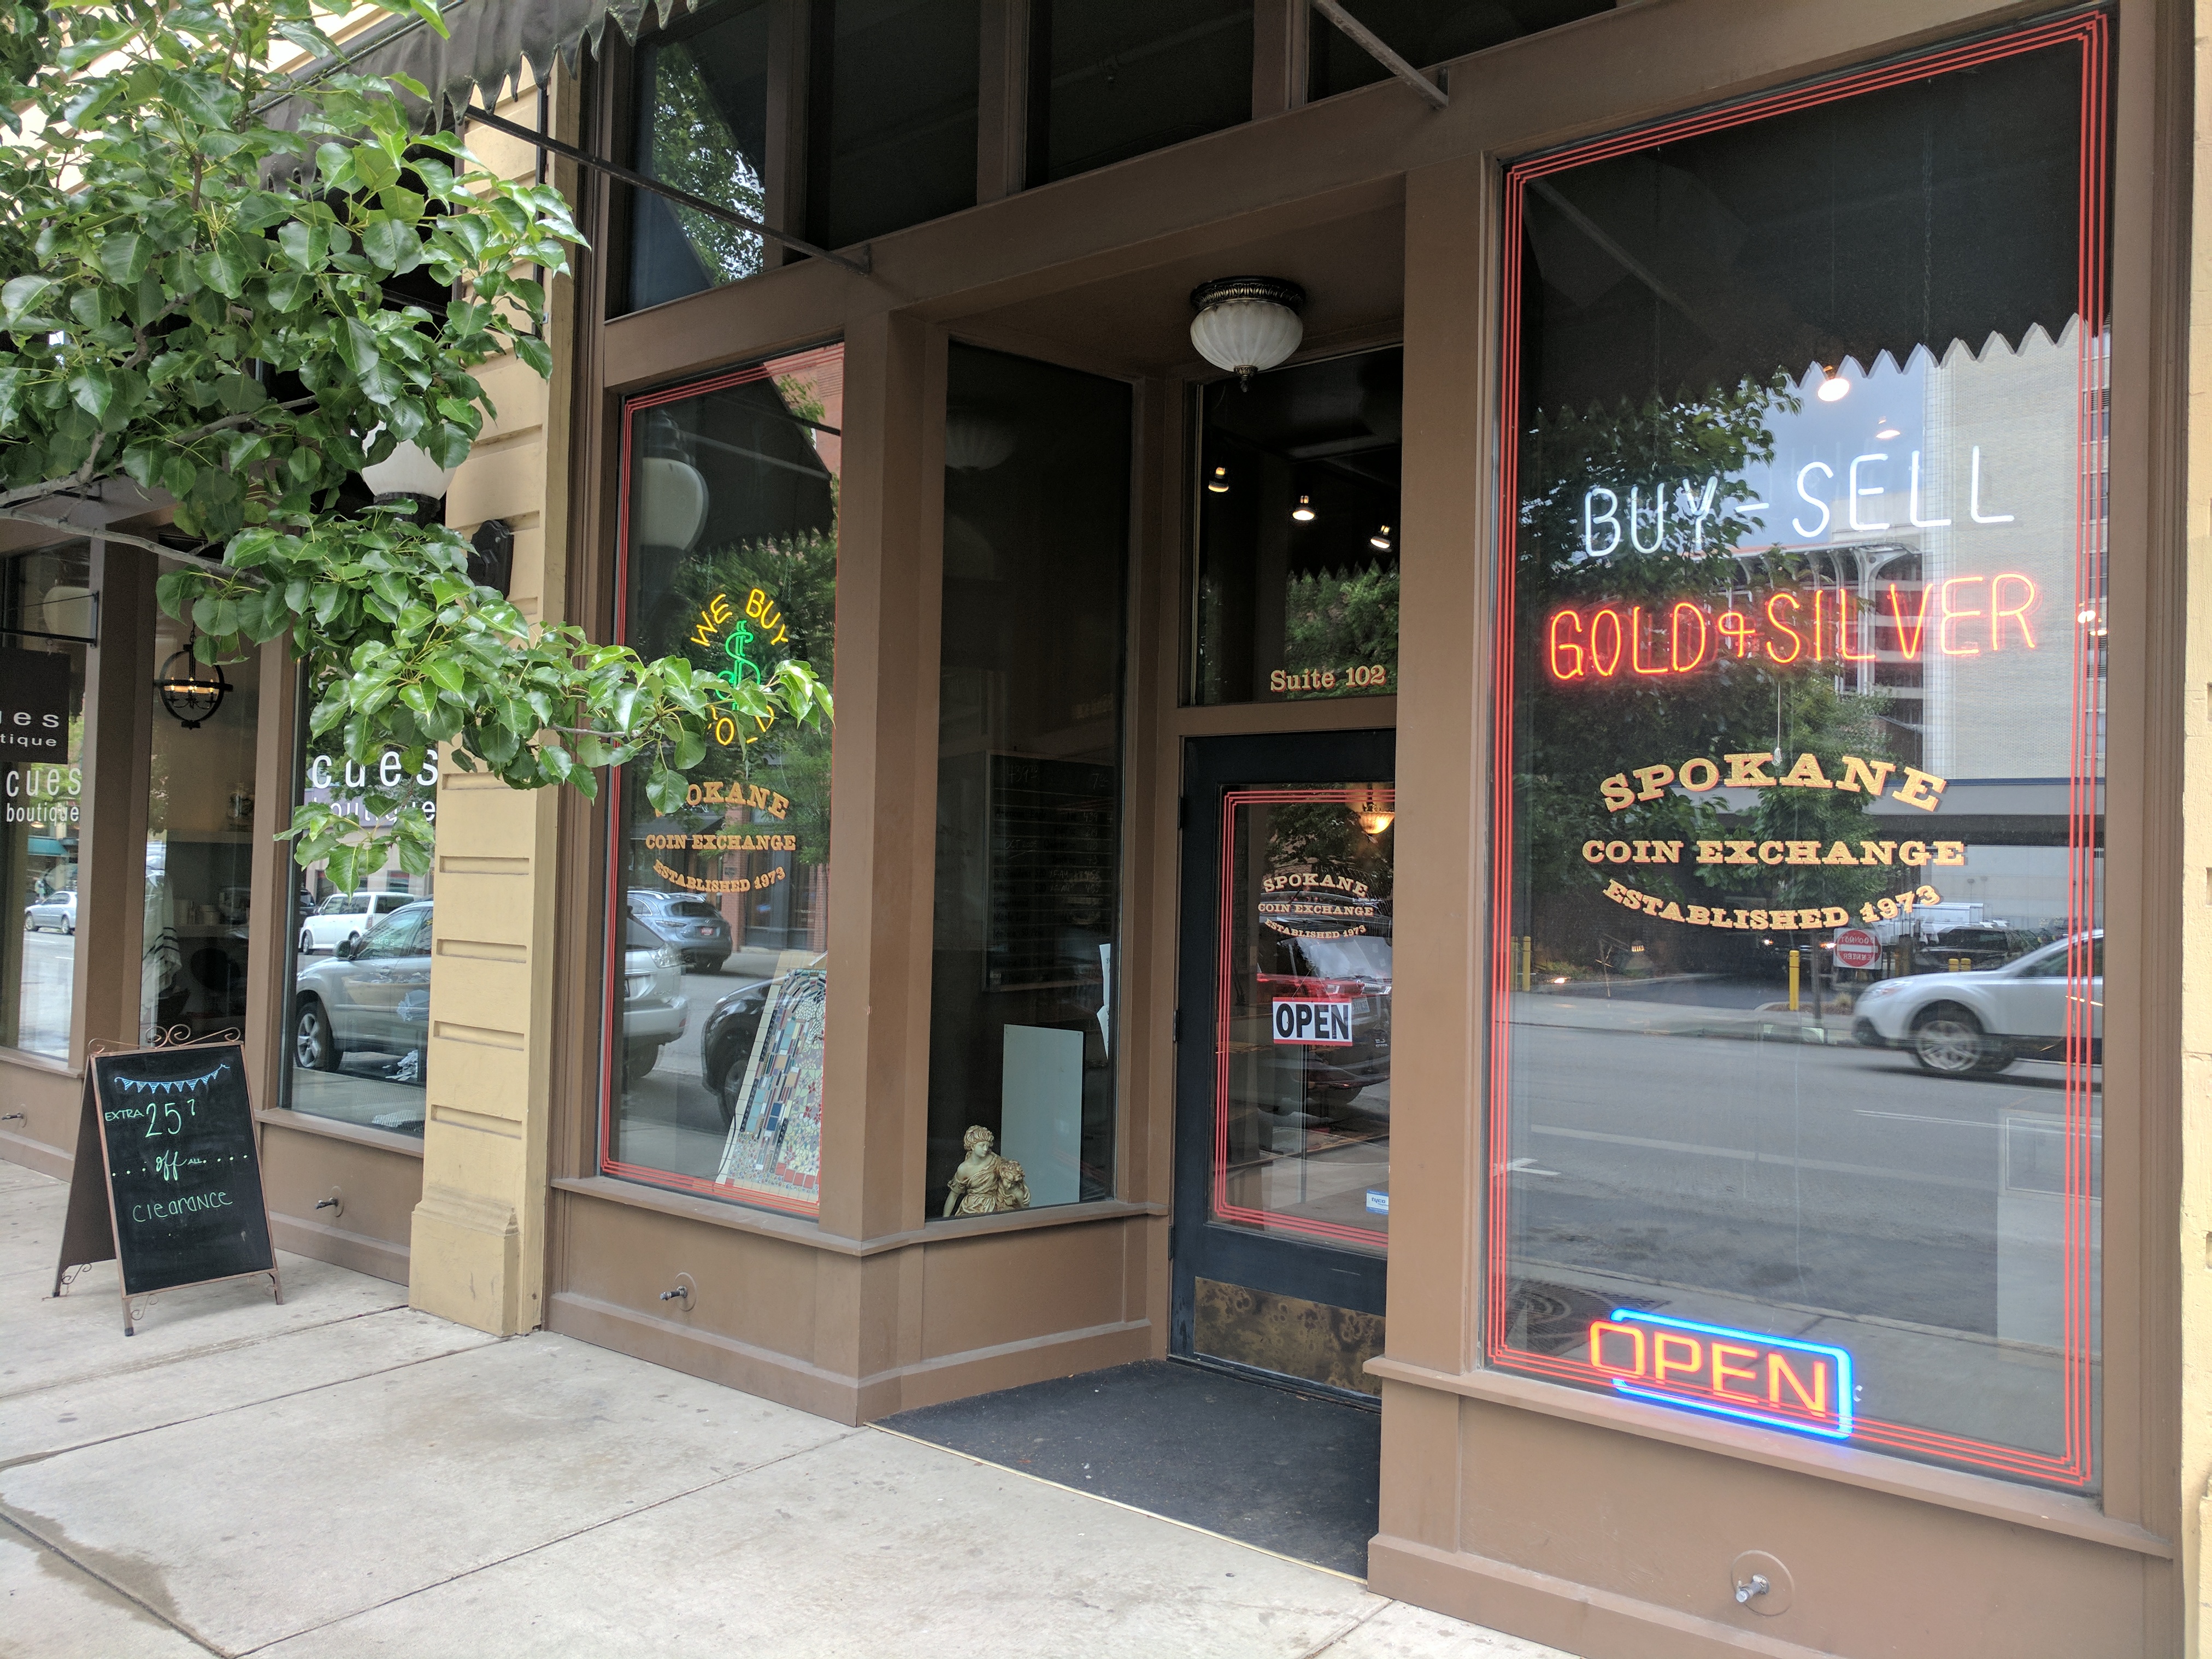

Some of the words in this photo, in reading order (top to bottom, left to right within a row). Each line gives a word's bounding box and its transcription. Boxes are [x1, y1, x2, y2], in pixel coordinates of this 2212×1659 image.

[1584, 475, 1719, 557] BUY
[1791, 444, 2015, 539] SELL
[690, 593, 733, 647] WE
[745, 588, 789, 646] BUY
[1550, 600, 1707, 681] GOLD
[1764, 572, 2038, 664] SILVER
[1270, 668, 1336, 692] Suite
[1345, 664, 1386, 688] 102
[0, 711, 59, 728] es
[6, 768, 81, 797] cues
[312, 749, 438, 789] cues
[1599, 752, 1948, 813] SPOKANE
[7, 802, 79, 826] boutique
[655, 781, 790, 820] OKANE
[645, 834, 687, 850] COIN
[691, 834, 796, 851] EXCHANGE
[1582, 839, 1684, 863] COIN
[1696, 840, 1966, 866] EXCHANGE
[653, 859, 751, 892] ESTABLISHED
[754, 866, 786, 890] 1973
[1263, 873, 1369, 898] SPOKANE
[1258, 903, 1291, 913] COIN
[1295, 904, 1375, 916] EXCHANGE
[1602, 879, 1849, 930] ESTABLISHED
[1859, 884, 1943, 923] 1973
[1264, 918, 1340, 939] ESTABLISHED
[1343, 925, 1366, 938] 1973
[1276, 1003, 1349, 1039] OPEN
[104, 1109, 144, 1121] EXTRA
[155, 1149, 187, 1181] off
[1589, 1320, 1827, 1419] OPEN
